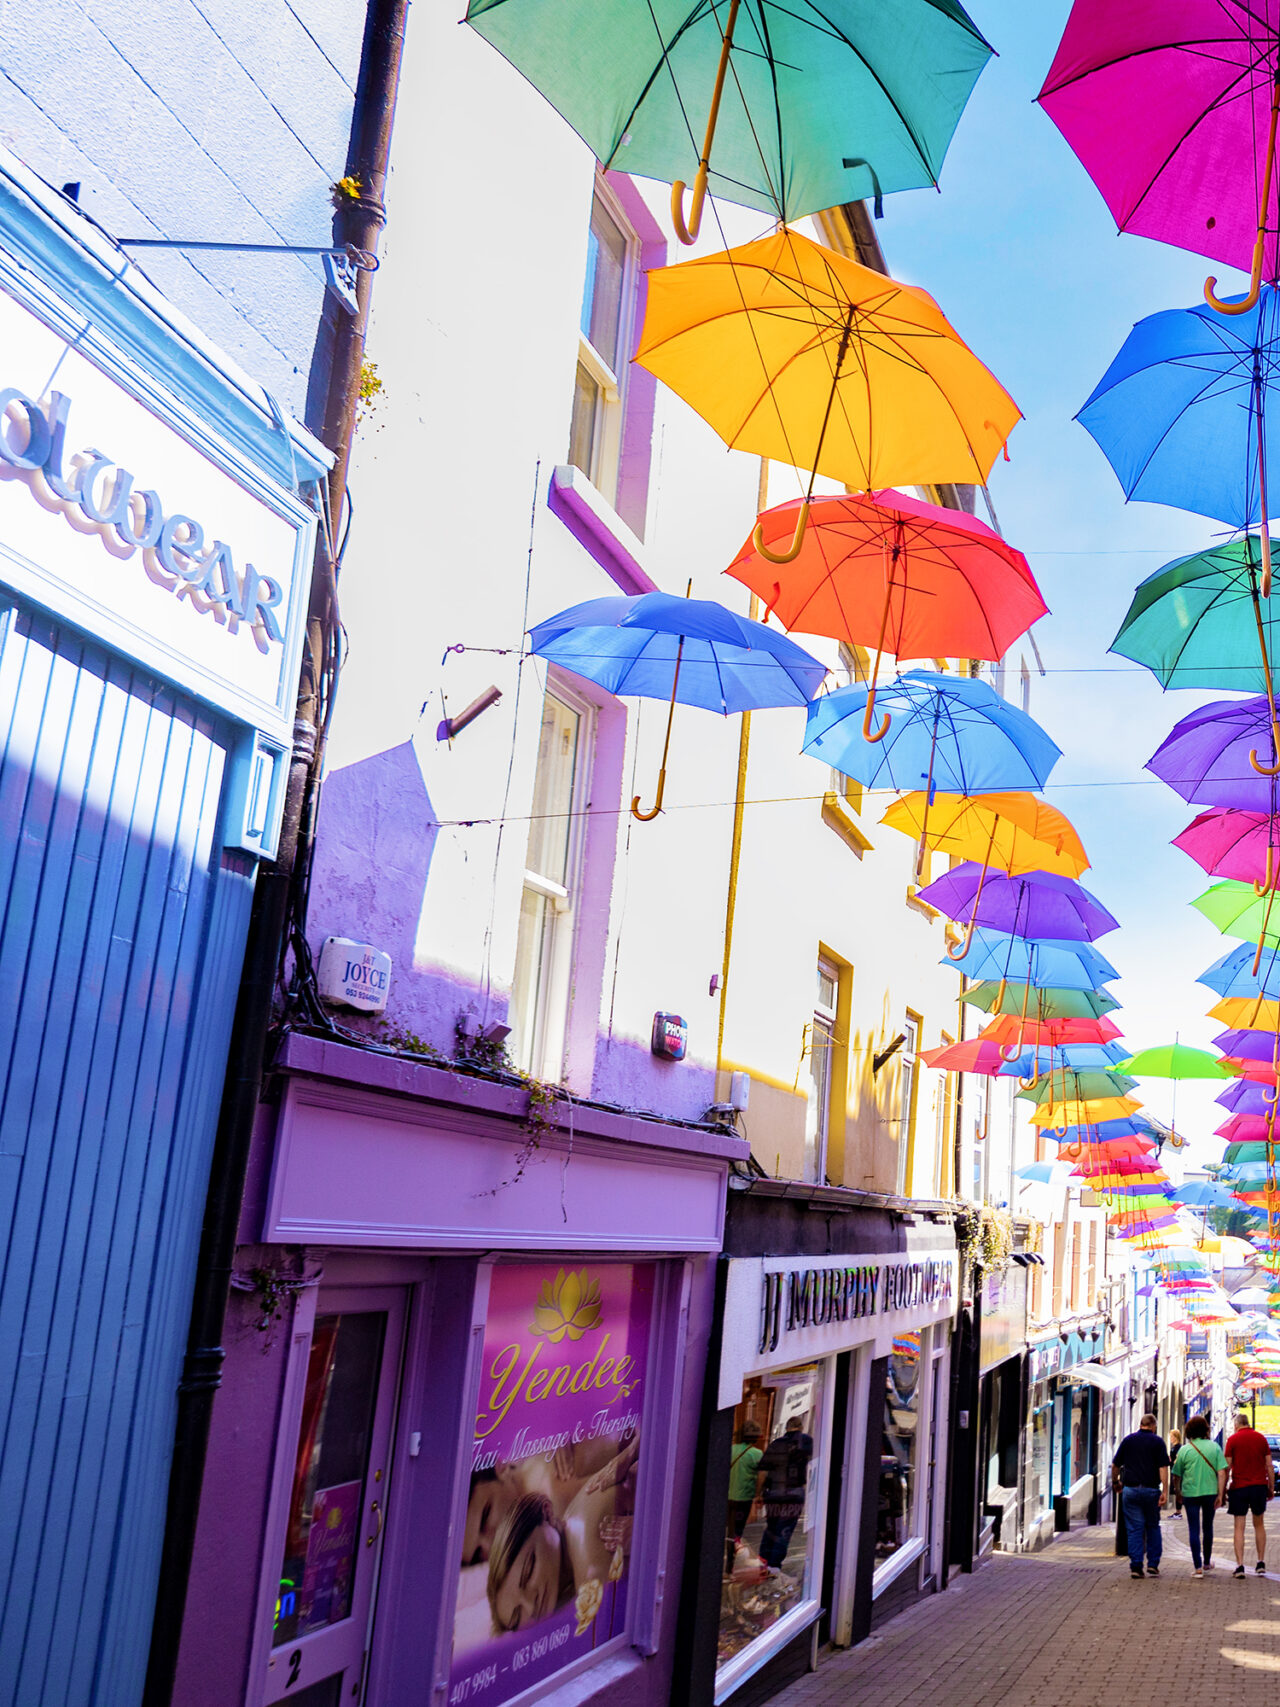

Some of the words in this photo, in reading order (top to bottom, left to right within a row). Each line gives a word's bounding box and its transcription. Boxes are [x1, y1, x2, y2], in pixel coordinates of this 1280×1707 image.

[342, 961, 387, 990] JOYCE
[759, 1271, 786, 1355] JJ
[787, 1265, 881, 1332] MURPHY
[882, 1257, 953, 1313] FOOTWEAR
[474, 1333, 636, 1439] Yendee
[502, 1426, 570, 1463] Massage
[572, 1420, 586, 1445] &
[587, 1408, 640, 1442] Therapy
[285, 1647, 302, 1689] 2
